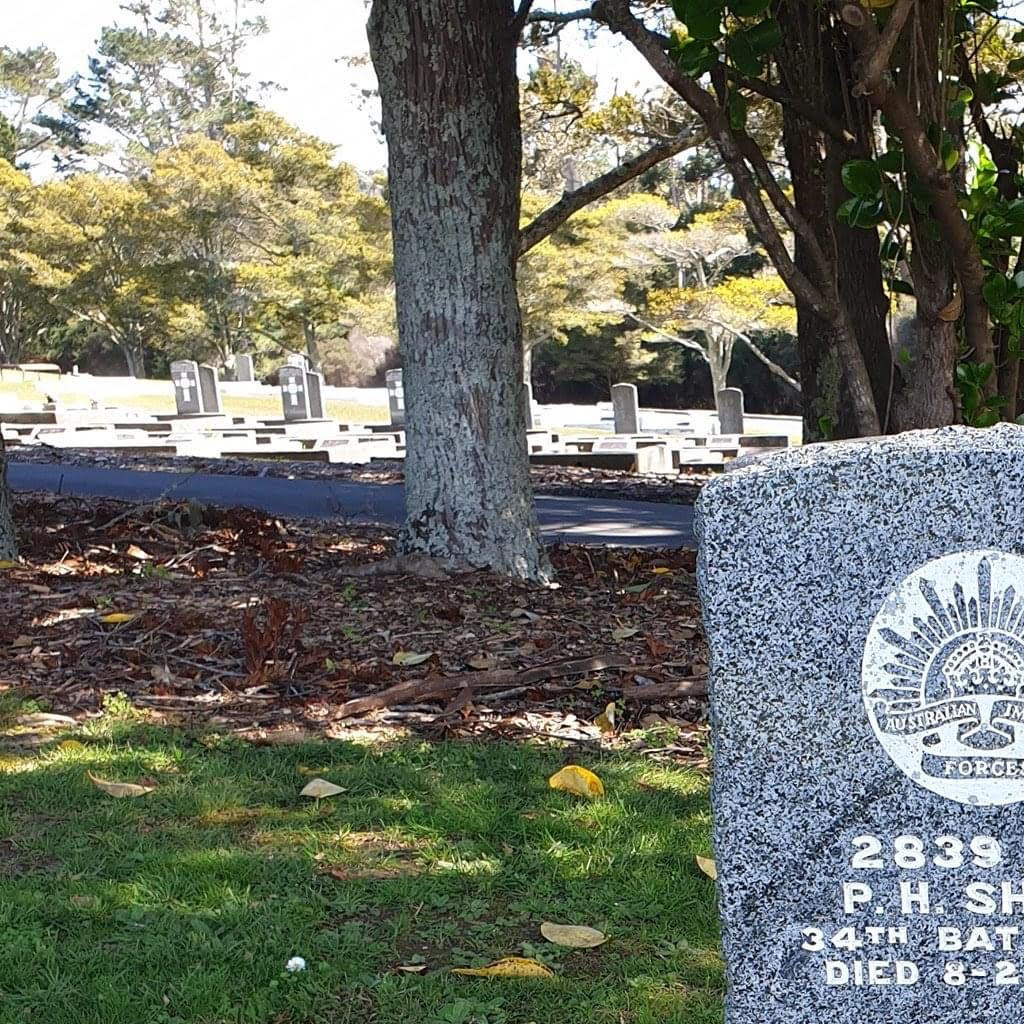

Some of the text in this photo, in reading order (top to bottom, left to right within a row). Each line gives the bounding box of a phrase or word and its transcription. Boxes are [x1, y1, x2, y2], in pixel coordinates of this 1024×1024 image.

[885, 700, 977, 731] AUSTRALIAN
[851, 835, 1000, 869] 2839
[802, 927, 908, 952] 34TH
[826, 961, 920, 985] DIED
